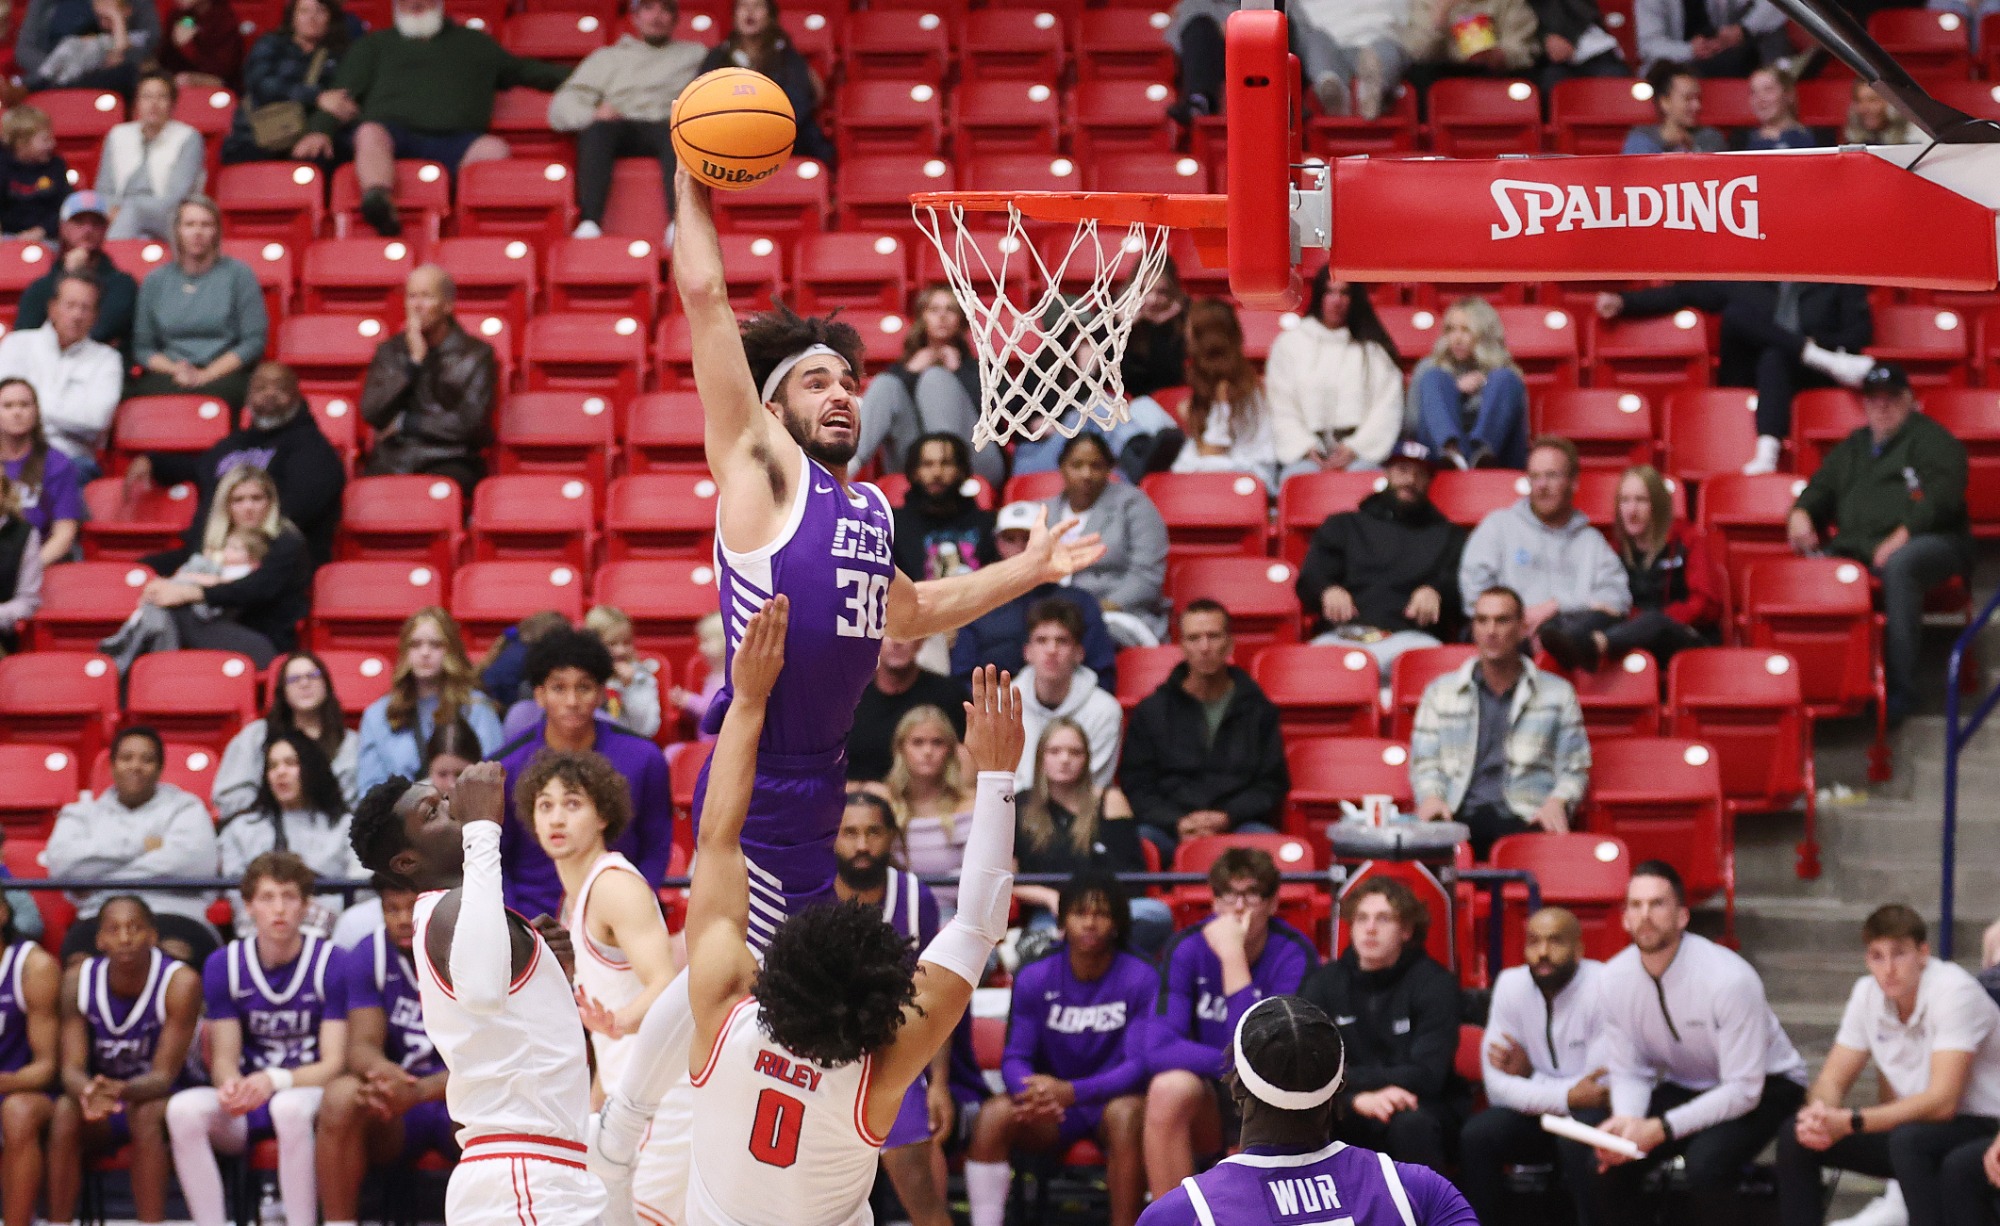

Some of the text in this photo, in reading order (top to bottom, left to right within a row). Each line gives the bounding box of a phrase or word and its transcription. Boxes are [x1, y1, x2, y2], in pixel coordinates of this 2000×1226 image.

[702, 159, 780, 183] Wilson
[1490, 175, 1760, 240] SPALDING
[831, 517, 892, 566] GCU
[836, 567, 890, 640] 30
[1047, 1000, 1127, 1034] LOPES
[753, 1048, 823, 1092] RILEY
[748, 1087, 806, 1169] 0
[1267, 1174, 1342, 1216] WUR
